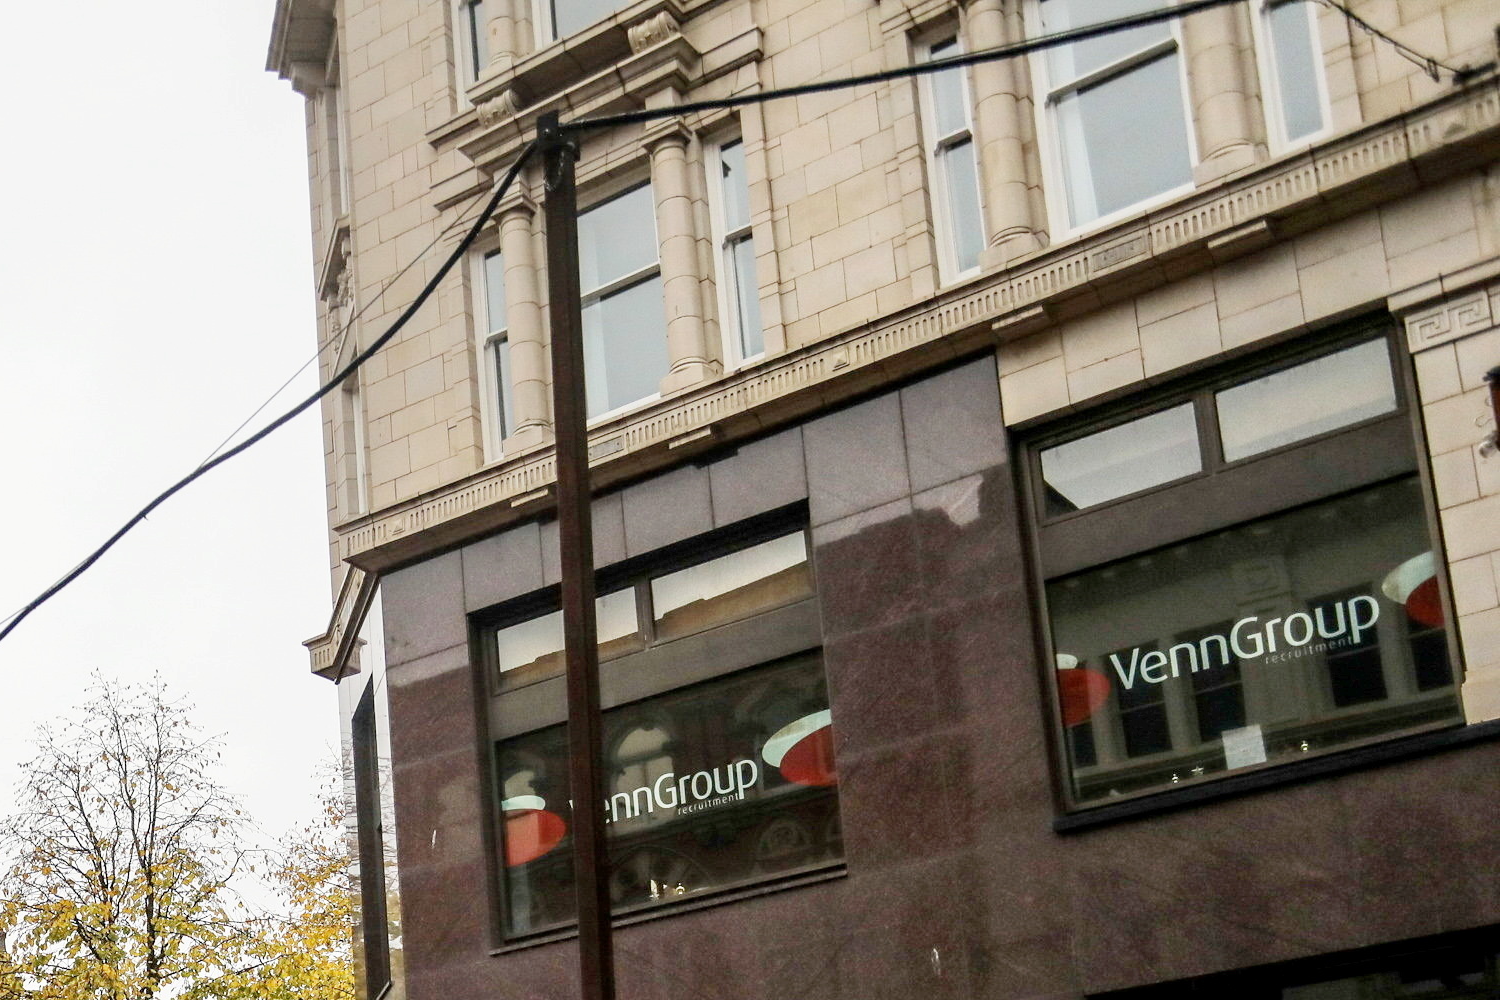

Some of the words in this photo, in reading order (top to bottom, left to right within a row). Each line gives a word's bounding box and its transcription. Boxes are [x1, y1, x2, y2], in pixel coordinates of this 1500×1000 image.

[1109, 595, 1380, 690] VennGroup
[1265, 635, 1353, 665] recruitment
[677, 792, 739, 815] recruitment
